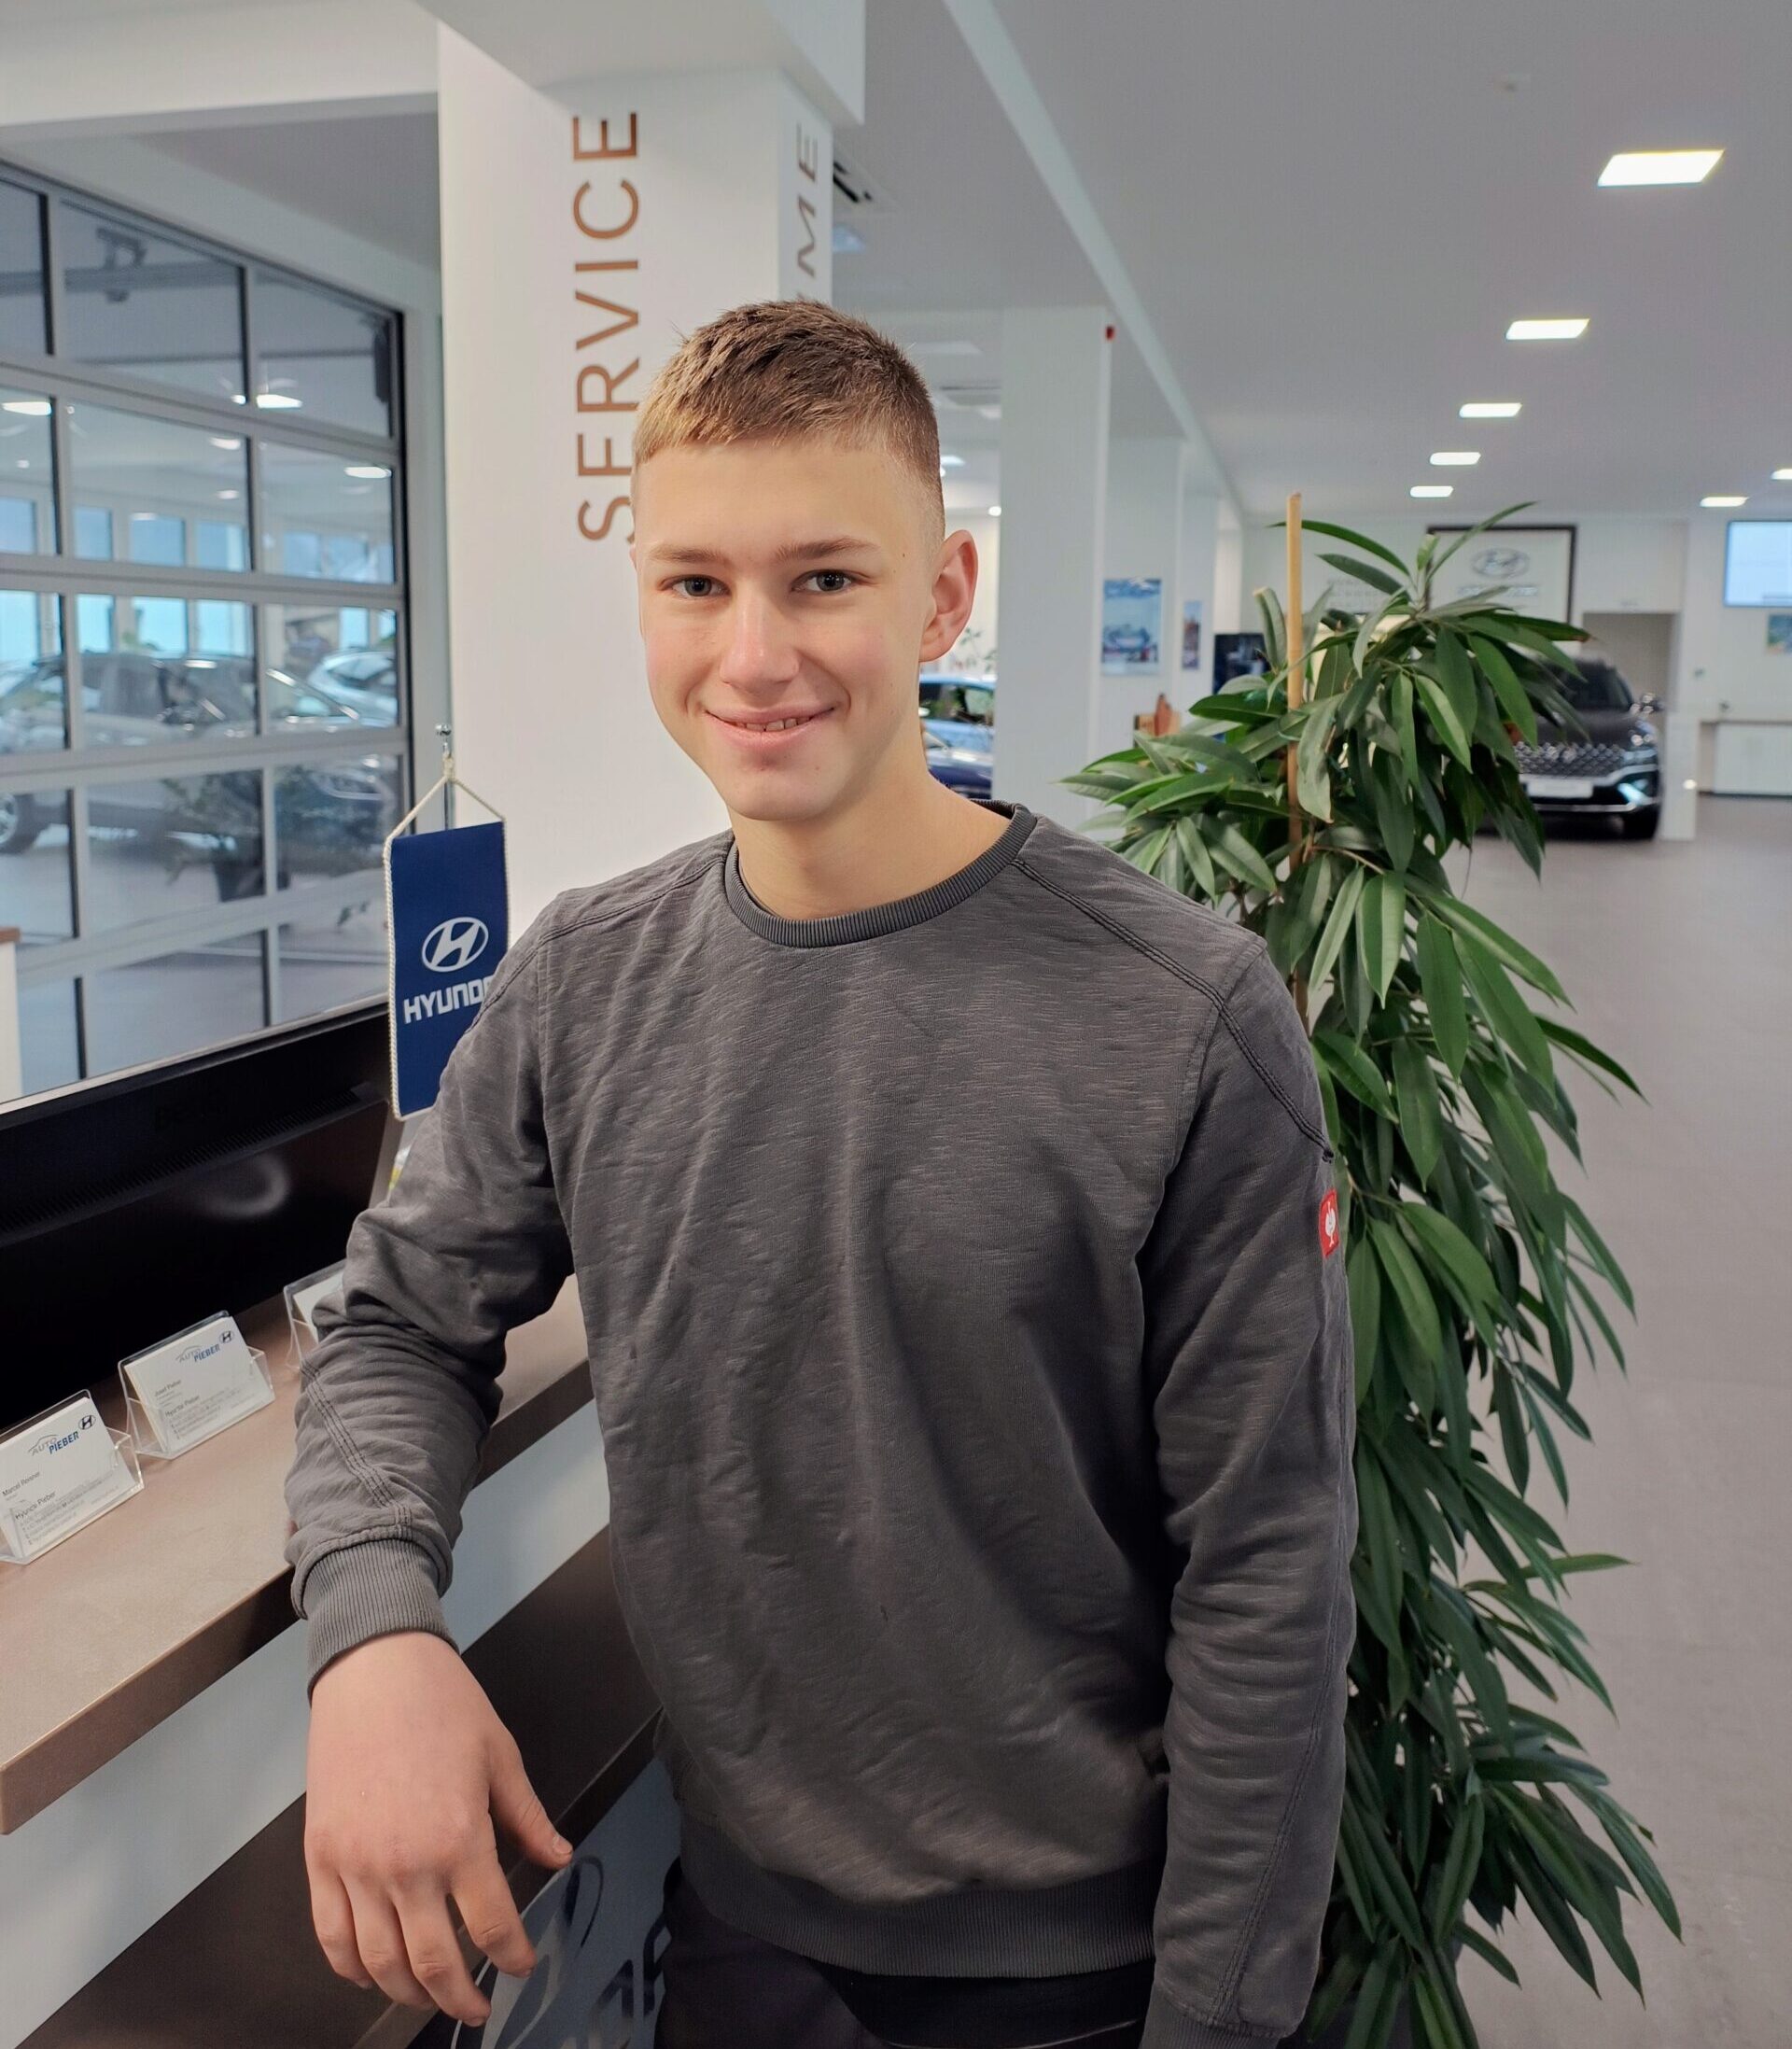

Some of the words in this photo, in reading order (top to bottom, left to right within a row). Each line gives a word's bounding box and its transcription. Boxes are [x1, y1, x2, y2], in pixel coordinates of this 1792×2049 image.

[795, 121, 819, 299] ME
[572, 111, 640, 543] SERVICE
[193, 1343, 220, 1363] PIEBER
[49, 1430, 80, 1454] PIEBER
